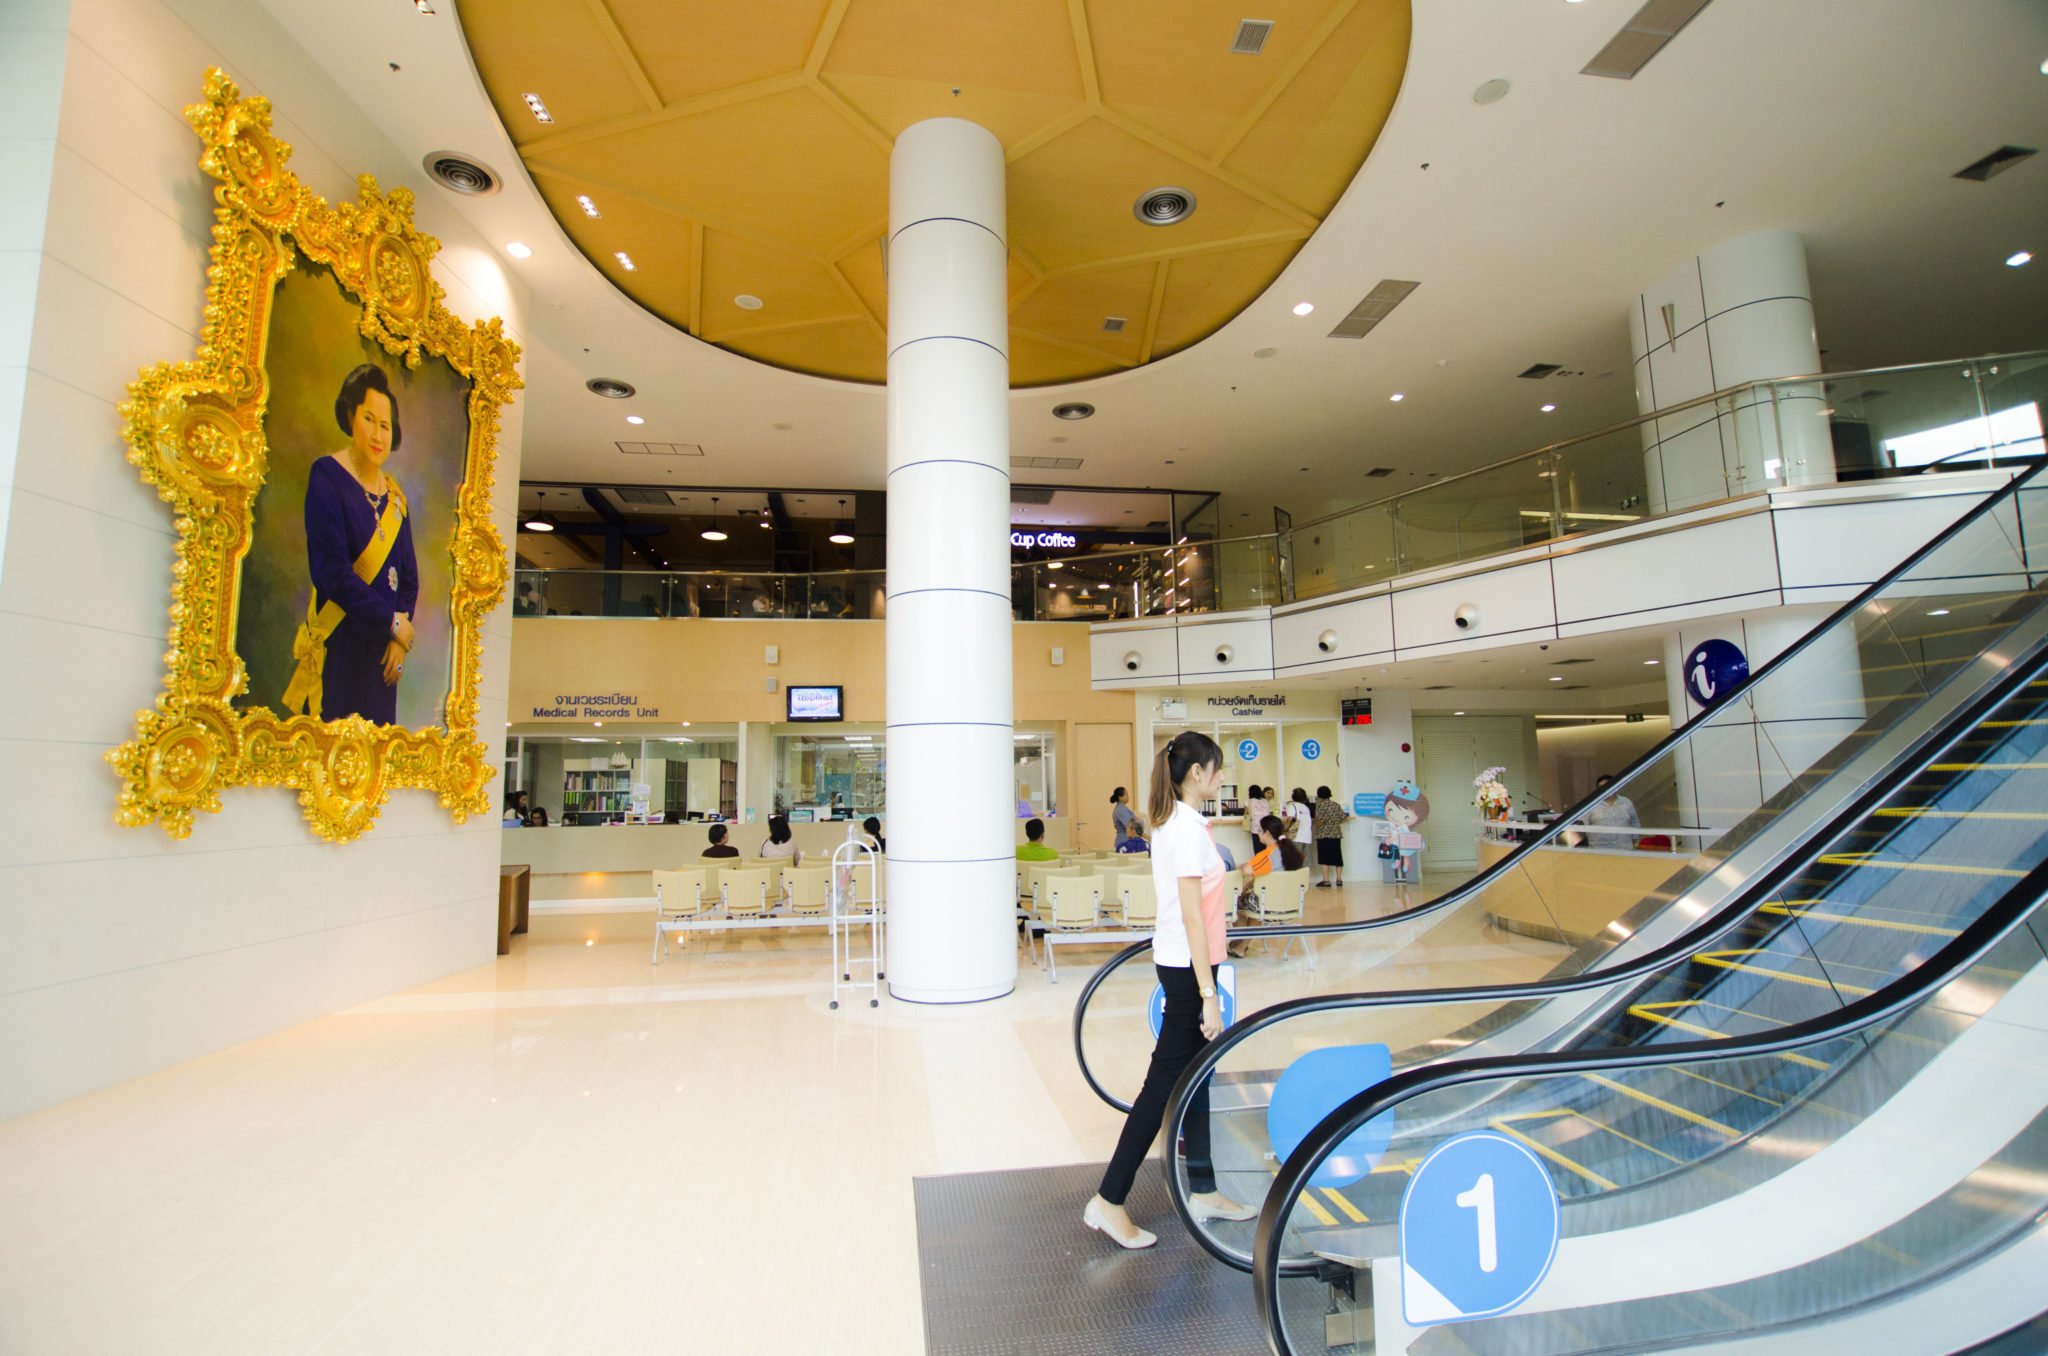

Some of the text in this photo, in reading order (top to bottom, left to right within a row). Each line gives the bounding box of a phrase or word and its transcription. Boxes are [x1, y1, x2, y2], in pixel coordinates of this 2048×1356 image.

[1010, 532, 1076, 549] Cup Coffee
[555, 693, 637, 705] งานเวชระเบียน
[1208, 694, 1286, 706] หน่วยจัดเก็บรายได้
[533, 707, 659, 717] Medical Records Unit
[1232, 707, 1263, 716] Cashier
[1244, 742, 1256, 759] 2
[1307, 742, 1318, 758] 3
[1456, 1173, 1498, 1273] 1
